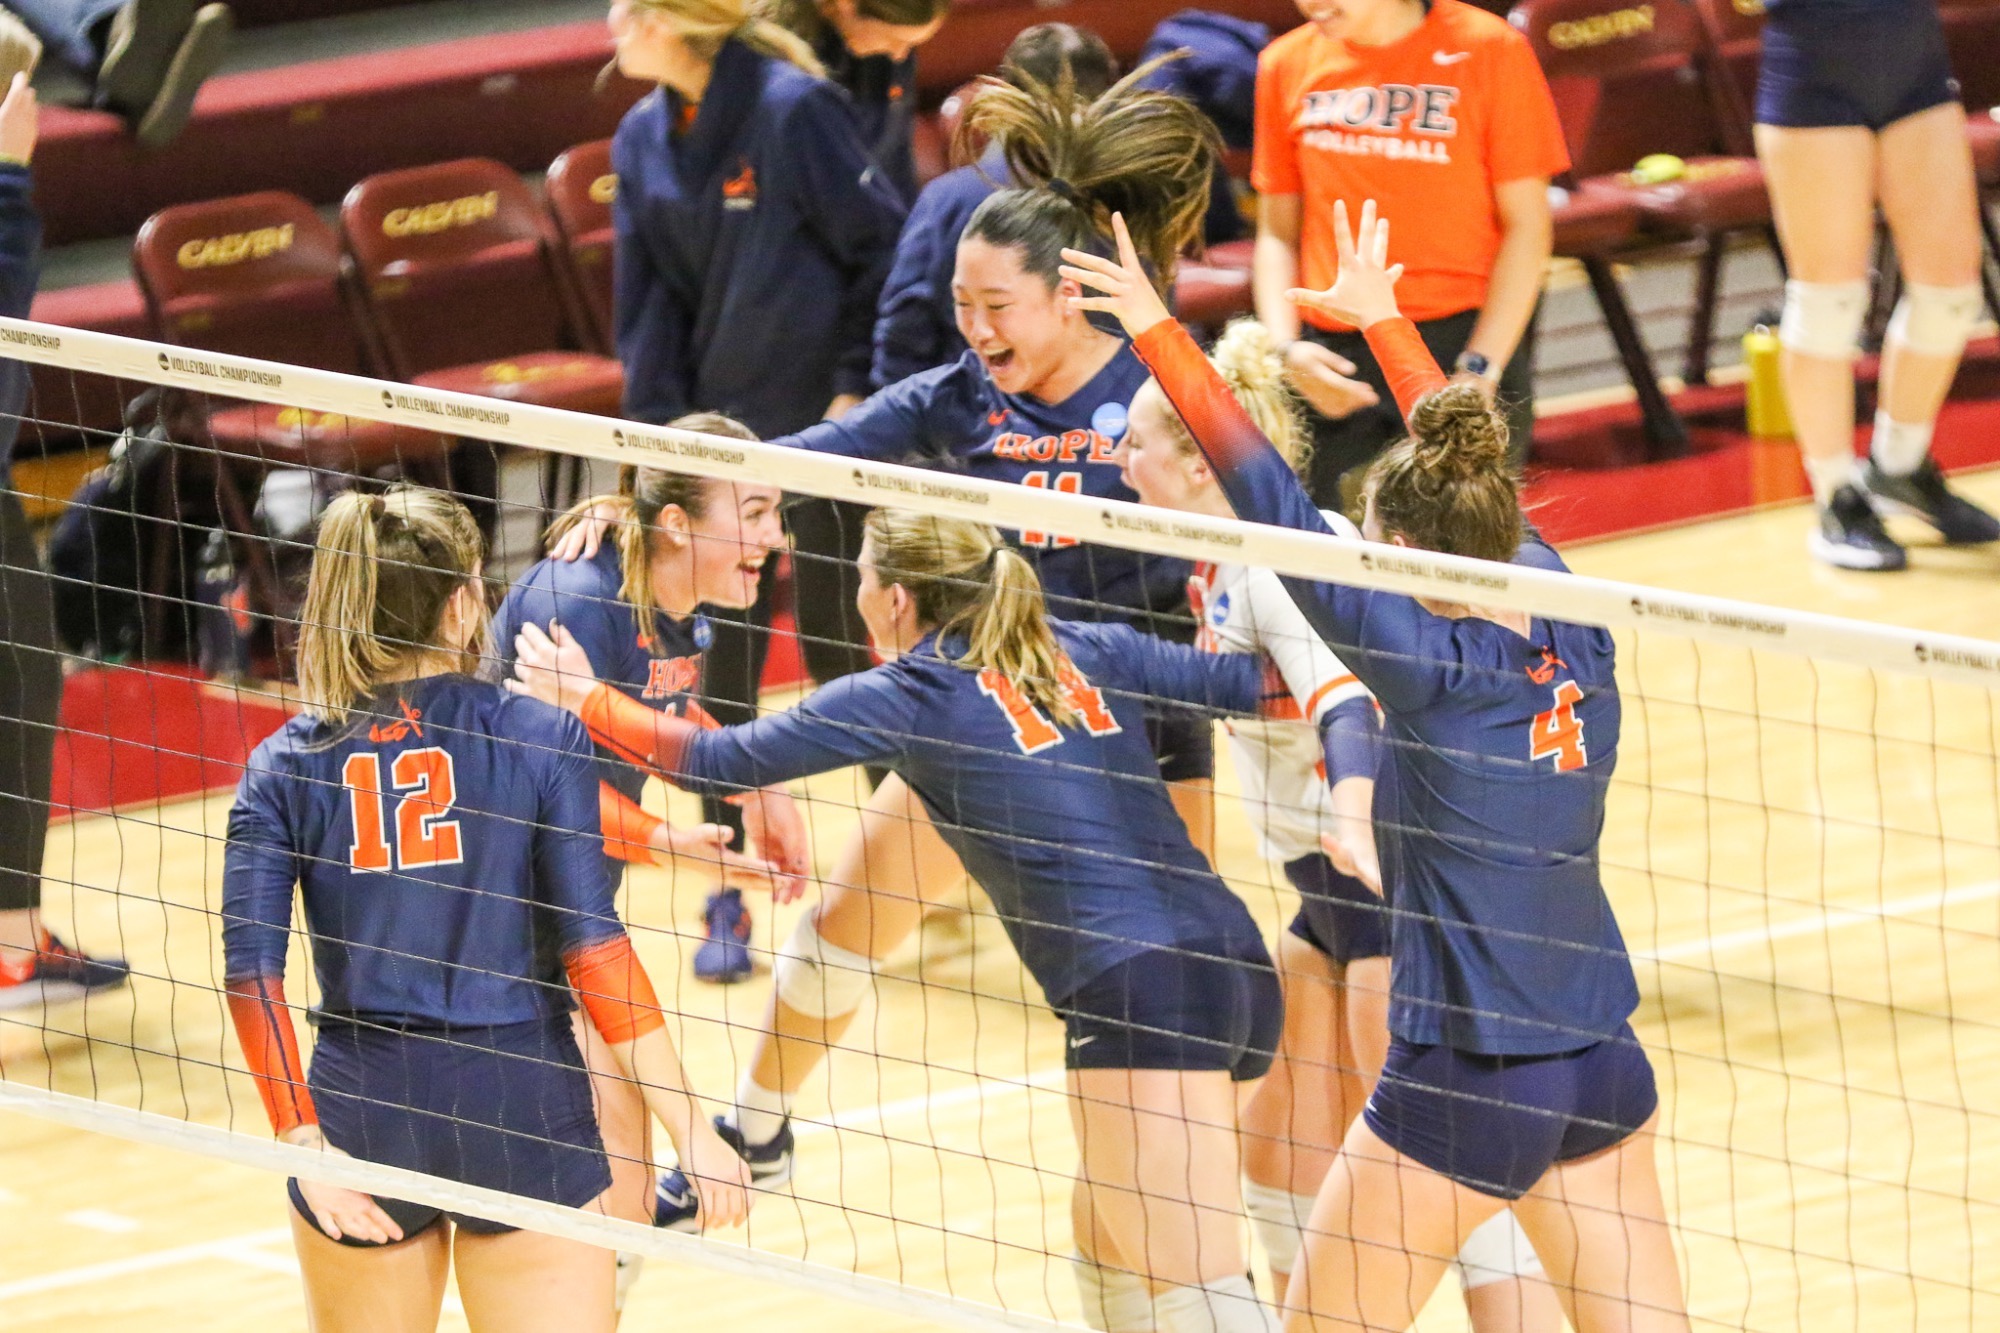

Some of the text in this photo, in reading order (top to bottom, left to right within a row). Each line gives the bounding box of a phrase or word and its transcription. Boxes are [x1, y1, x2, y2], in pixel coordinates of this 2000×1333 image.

[1302, 82, 1461, 138] HOPE
[0, 327, 61, 350] CHAMPIONSHIP
[170, 356, 282, 388] VOLLEYBALL CHAMPIONSHIP
[394, 394, 510, 427] VOLLEYBALL CHAMPIONSHIP
[626, 433, 745, 466] VOLLEYBALL CHAMPIONSHIP
[992, 428, 1116, 464] HOPE
[866, 472, 989, 506] VOLLEYBALL CHAMPIONSHIP
[1116, 514, 1243, 547] VOLLEYBALL CHAMPIONSHIP
[1376, 555, 1509, 591] VOLLEYBALL CHAMPIONSHIP
[1647, 600, 1787, 636] VOLLEYBALL CHAMPIONSHIP
[1932, 646, 1992, 671] VOLLEYBALL
[1529, 679, 1588, 773] 4
[342, 746, 463, 874] 12
